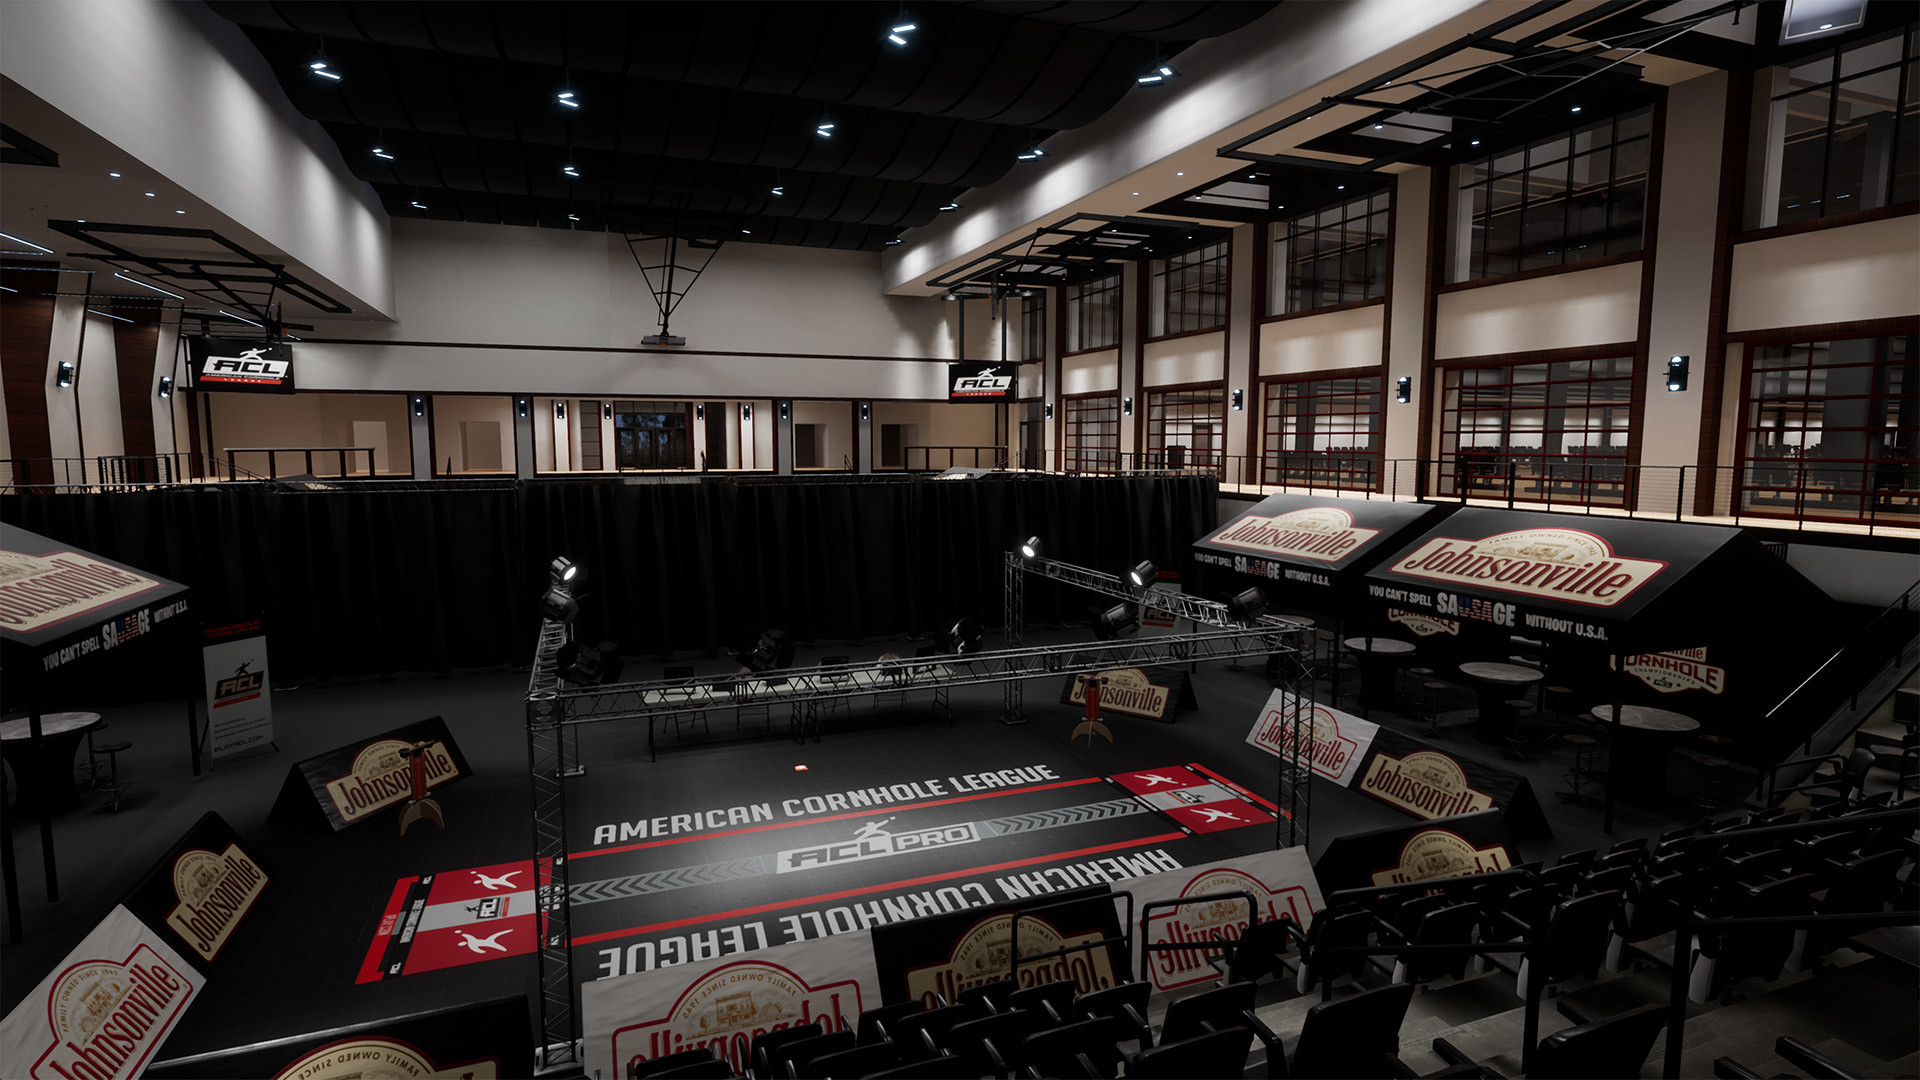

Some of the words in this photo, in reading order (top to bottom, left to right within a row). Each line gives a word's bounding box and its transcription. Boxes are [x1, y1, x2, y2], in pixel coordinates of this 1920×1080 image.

[213, 360, 281, 374] ACL
[961, 379, 1004, 388] ACL
[1219, 519, 1359, 556] Johnsonville
[1218, 556, 1232, 568] SPELL
[1234, 556, 1280, 580] SAUSAGE
[1284, 568, 1312, 584] WITHOUT
[1312, 572, 1331, 587] U.S.A.
[1404, 542, 1633, 597] Johnsonville
[1369, 584, 1385, 598] YOU
[1385, 586, 1408, 602] CAN'T
[1409, 591, 1432, 607] SPELL
[1436, 592, 1516, 628] SAUSAGE
[1525, 613, 1573, 635] WITHOUT
[1575, 623, 1609, 642] U.S.A.
[43, 652, 60, 672] YOU
[60, 644, 81, 665] CAN'T
[81, 635, 101, 653] SPELL
[220, 676, 260, 697] ACL
[1615, 655, 1718, 690] ORNHOLE
[1074, 682, 1162, 713] Jnsonville
[338, 749, 451, 815] Johnsonille
[593, 802, 774, 846] AMERICAN
[782, 779, 948, 817] CORNHOLE
[948, 764, 1060, 793] LEAGUE
[785, 840, 888, 868] ACL
[895, 825, 970, 850] PRO
[995, 848, 1184, 900] AMERICAN
[175, 855, 261, 953] Johnsonville
[480, 898, 498, 918] ACL
[779, 882, 995, 944] CORNHOLE
[597, 921, 768, 981] LEAGUE
[64, 979, 79, 1002] OWNED
[80, 969, 99, 981] SINCE
[101, 969, 119, 977] 1945
[61, 1003, 70, 1033] FAMILY
